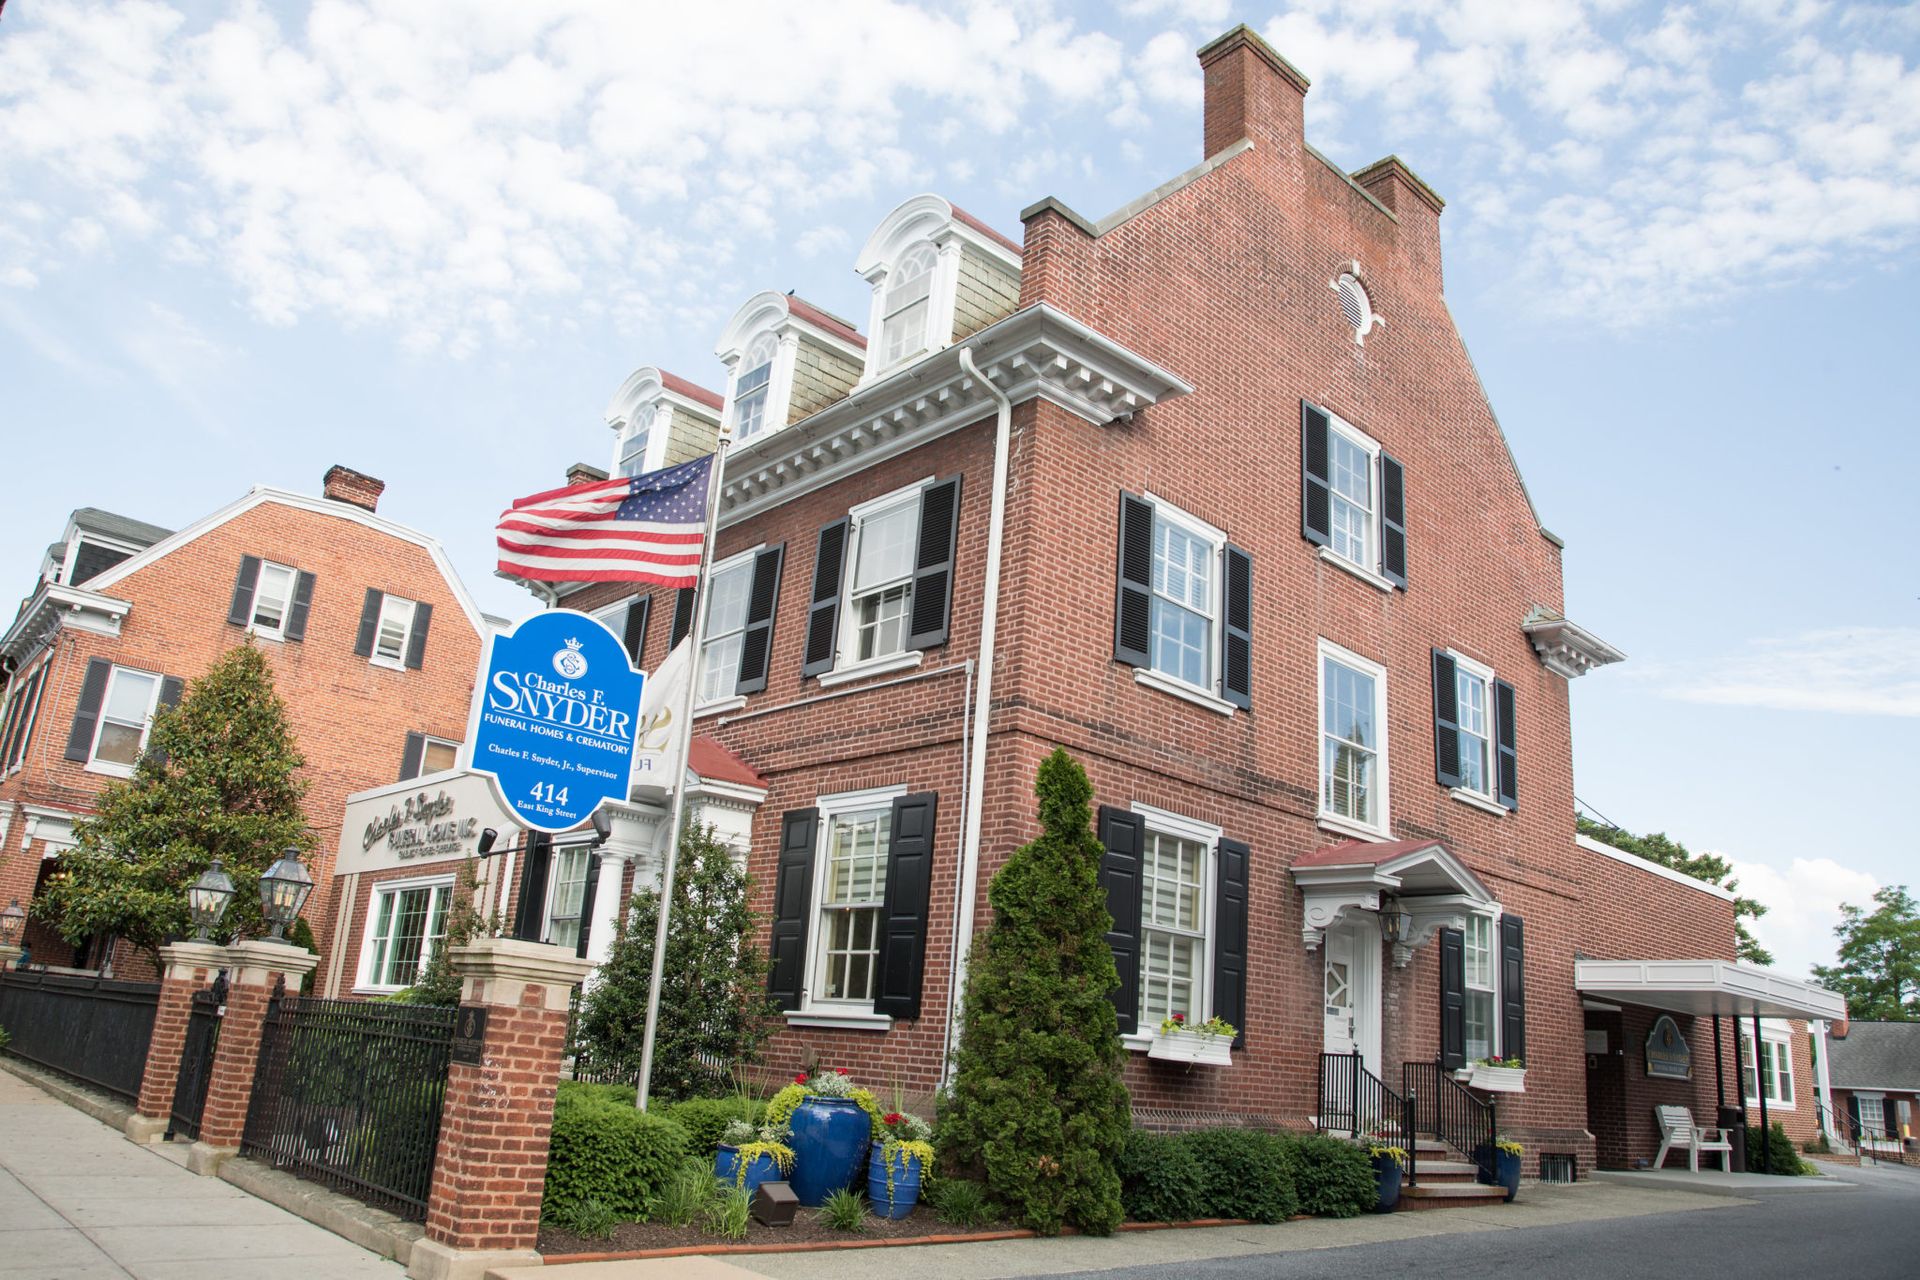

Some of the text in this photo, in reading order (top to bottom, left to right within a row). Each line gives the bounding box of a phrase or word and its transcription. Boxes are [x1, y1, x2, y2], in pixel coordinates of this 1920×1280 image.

[488, 670, 631, 740] SNYDER
[524, 672, 605, 706] Charles F.
[484, 712, 630, 756] FUNERAL HOMES & CREMATORY
[488, 743, 618, 780] Charles F. Snyder, Jr., Supervisor
[517, 800, 577, 819] East King Street
[529, 781, 569, 807] 414
